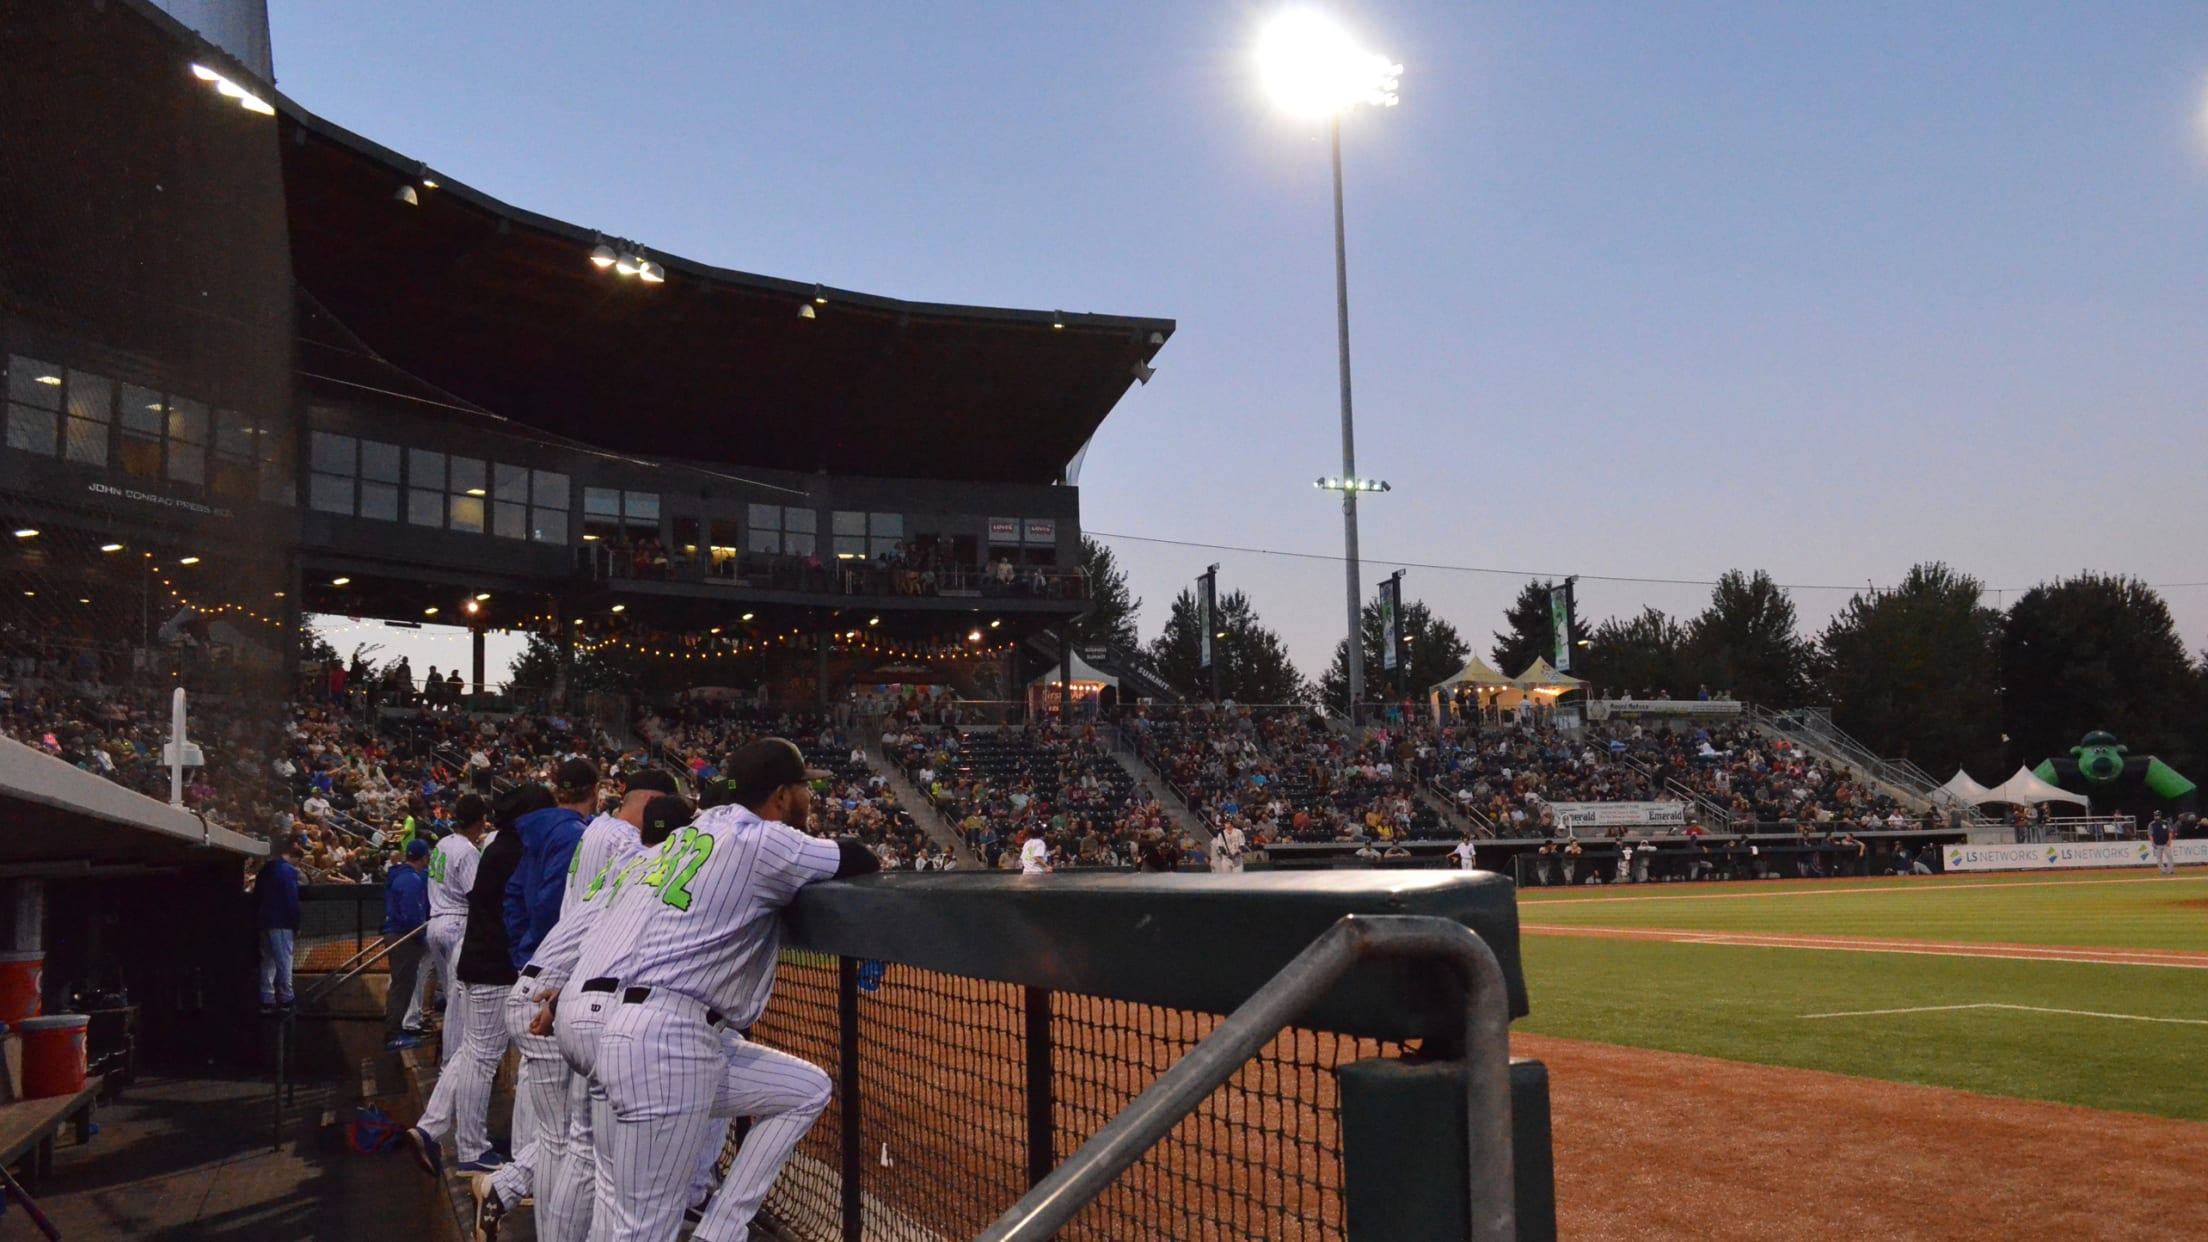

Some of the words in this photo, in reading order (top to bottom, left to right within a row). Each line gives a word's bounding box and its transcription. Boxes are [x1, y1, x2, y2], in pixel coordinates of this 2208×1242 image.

[88, 482, 122, 496] JOHN
[125, 489, 173, 507] CONRAD
[175, 499, 211, 514] PRESS
[1136, 666, 1170, 691] SUMMIT
[1649, 810, 1682, 821] Emerald
[1966, 852, 1978, 863] LS
[1980, 850, 2039, 863] NETWORKS
[2061, 849, 2073, 860] LS
[2074, 847, 2130, 860] NETWORKS
[2171, 844, 2208, 857] ETWOR
